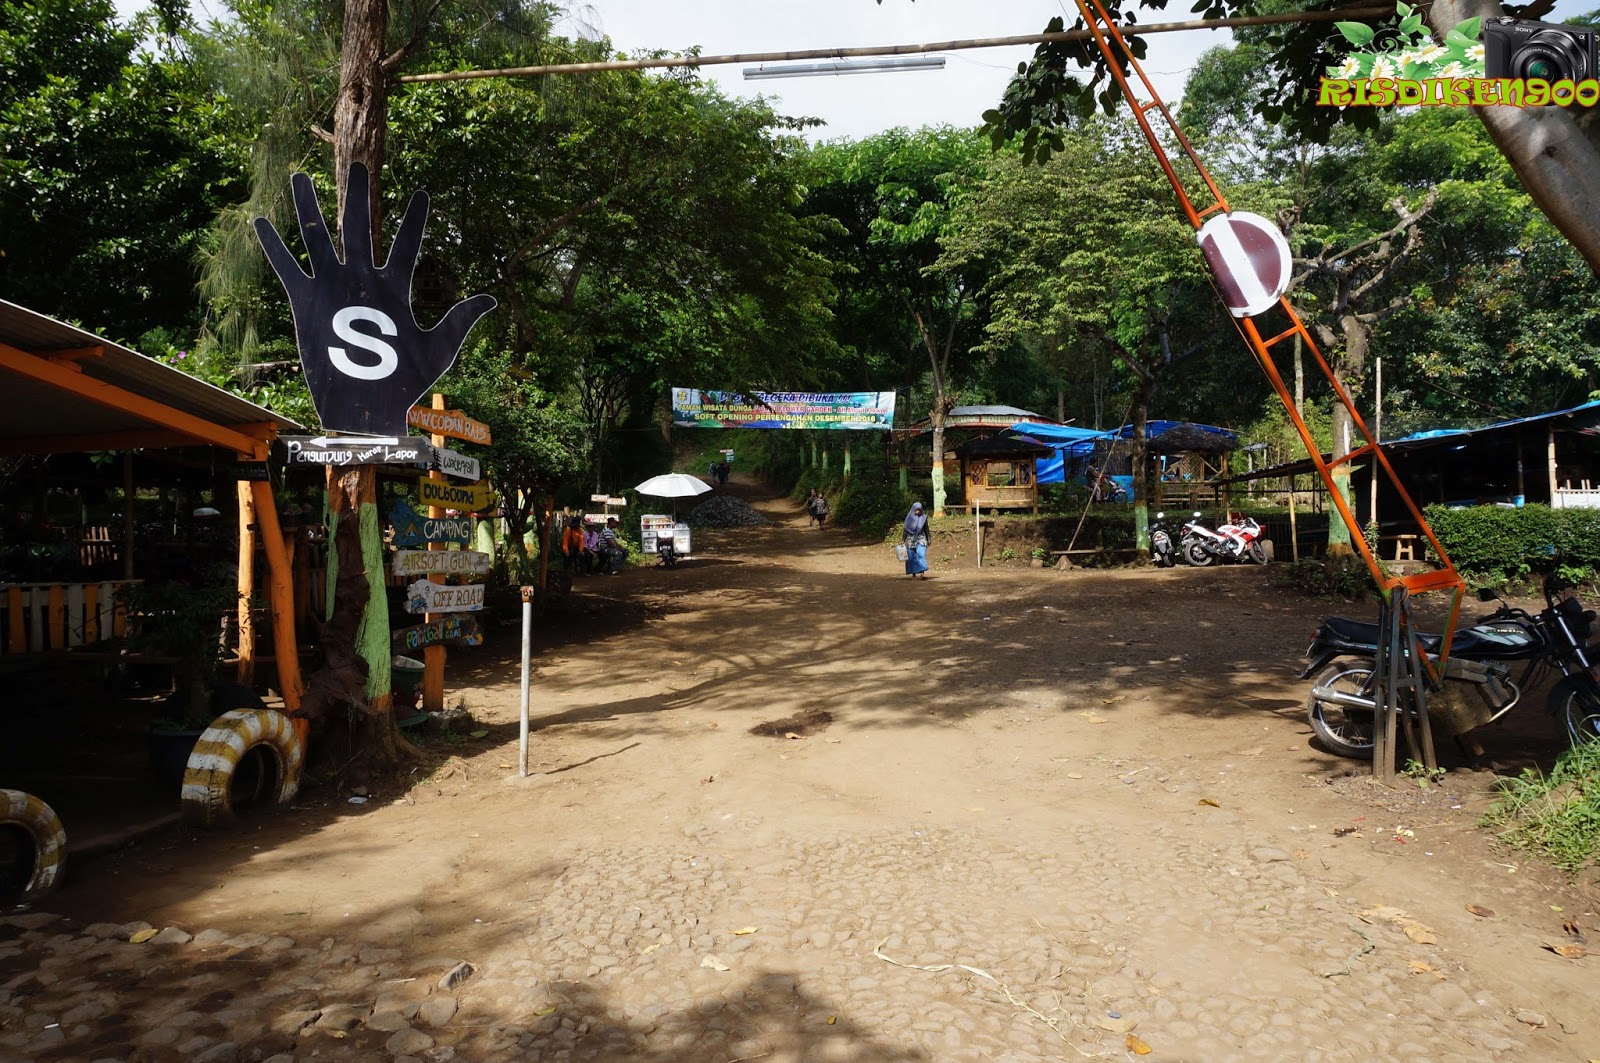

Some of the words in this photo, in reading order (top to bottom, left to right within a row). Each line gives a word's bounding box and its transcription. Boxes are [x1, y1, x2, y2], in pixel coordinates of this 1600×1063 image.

[328, 306, 398, 380] S
[757, 392, 796, 402] SEGERA
[797, 393, 835, 403] DIBUKA
[702, 404, 728, 412] WISATA
[729, 405, 753, 413] BUNGA
[777, 405, 805, 413] FLOWER
[806, 405, 832, 413] GARDEN
[717, 413, 754, 421] OPENING
[755, 413, 812, 422] PERTENGAHAN
[815, 414, 856, 422] DESEMBER
[384, 446, 418, 462] Lapor
[424, 520, 469, 539] CAMPING
[450, 552, 472, 571] GUN
[433, 590, 454, 608] OFF
[454, 587, 484, 607] ROAD
